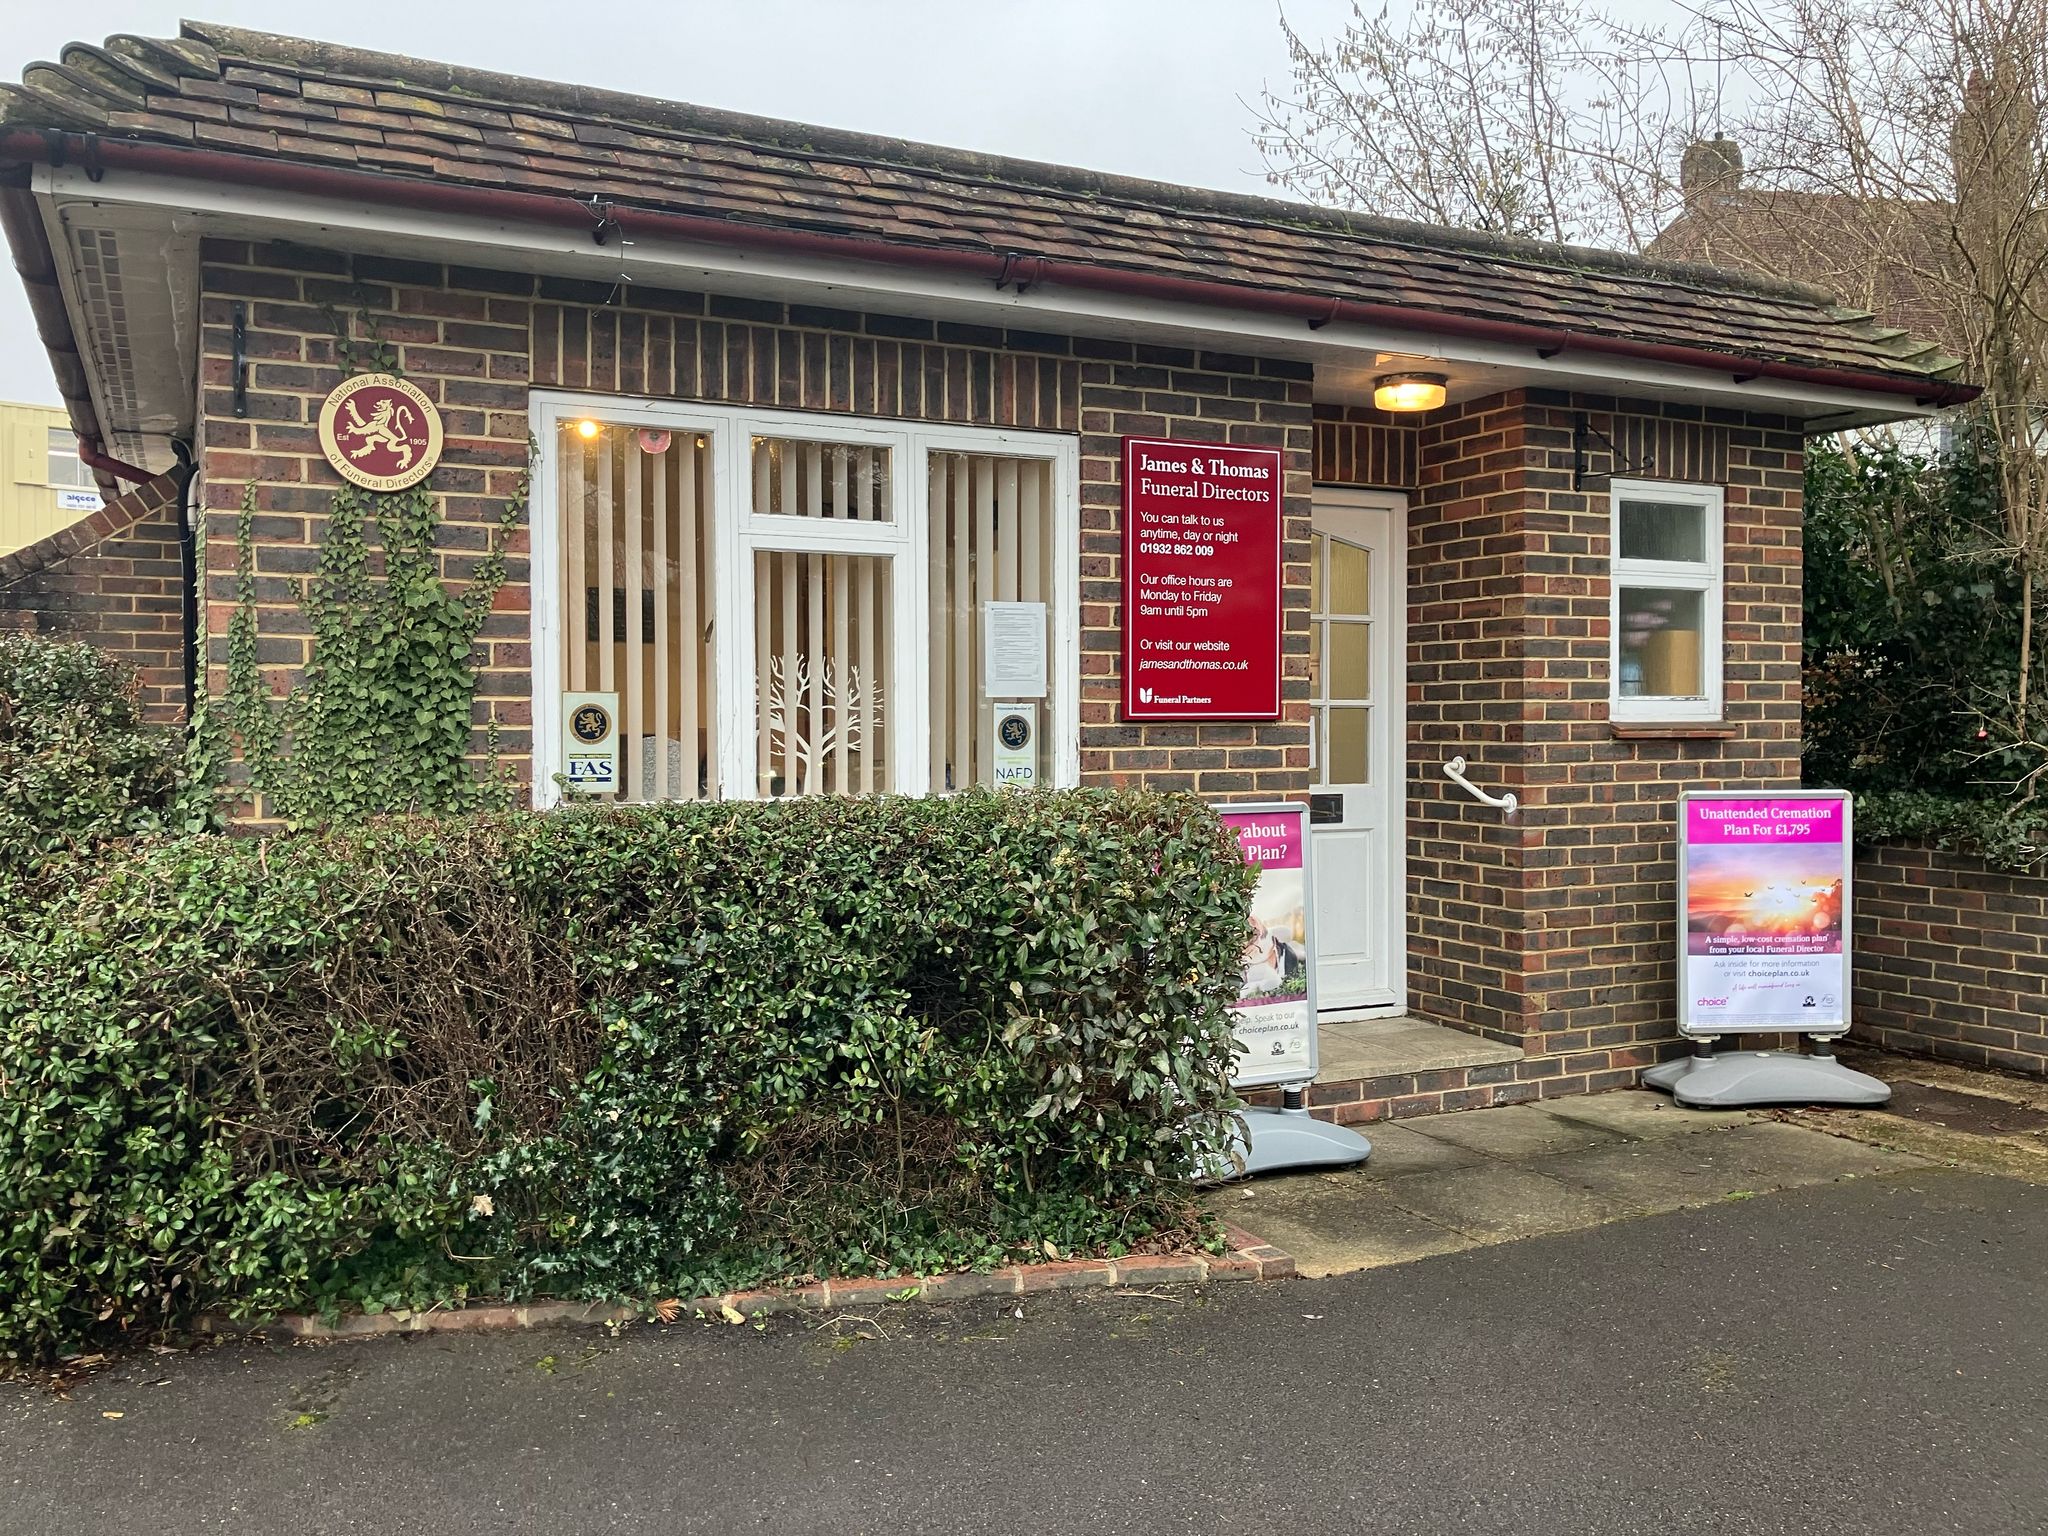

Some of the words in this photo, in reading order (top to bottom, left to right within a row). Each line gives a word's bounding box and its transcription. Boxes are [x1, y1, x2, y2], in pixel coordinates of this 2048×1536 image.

[328, 377, 369, 407] National
[372, 376, 432, 413] Association
[337, 433, 349, 441] Est
[409, 438, 427, 446] 1905
[330, 454, 342, 465] of
[341, 464, 382, 488] Funeral
[1140, 454, 1187, 474] James
[1191, 457, 1205, 475] &
[1208, 458, 1269, 479] Thomas
[1141, 477, 1198, 498] Funeral
[1202, 482, 1270, 502] Directors
[1140, 511, 1158, 523] You
[1161, 514, 1179, 524] can
[1181, 514, 1198, 525] talk
[1201, 515, 1211, 526] to
[1213, 517, 1224, 527] us
[1140, 528, 1180, 541] anytime,
[1183, 529, 1200, 543] day
[1203, 532, 1213, 541] or
[1215, 531, 1239, 544] night
[1140, 542, 1171, 554] 01932
[1174, 544, 1193, 555] 862
[1195, 545, 1214, 556] 009
[1140, 573, 1158, 585] Our
[1161, 574, 1186, 586] office
[1188, 575, 1215, 587] hours
[1217, 578, 1232, 587] are
[1140, 589, 1179, 603] Monday
[1181, 591, 1191, 601] to
[1193, 590, 1222, 604] Friday
[1140, 604, 1161, 615] 9am
[1164, 605, 1184, 616] until
[1186, 606, 1208, 618] 5pm
[1140, 639, 1152, 650] Or
[1155, 640, 1173, 650] visit
[1175, 641, 1191, 650] our
[1193, 640, 1229, 651] website
[1138, 659, 1249, 671] jamesandthomas.co.uk
[1154, 695, 1180, 704] Funeral
[1182, 695, 1212, 704] Partners
[569, 761, 612, 775] FAS
[996, 767, 1033, 779] NAFD
[1700, 807, 1768, 819] Unattended
[1770, 807, 1831, 819] Cremation
[1243, 822, 1287, 838] about
[1724, 823, 1750, 835] Plan
[1753, 824, 1772, 835] For
[1775, 823, 1810, 836] £1,795
[1247, 844, 1287, 861] Plan?
[1705, 936, 1711, 944] A
[1713, 936, 1740, 945] simple,
[1741, 935, 1773, 943] low-cost
[1774, 934, 1810, 943] cremation
[1709, 946, 1727, 954] from
[1728, 946, 1745, 955] your
[1746, 945, 1765, 953] local
[1766, 945, 1795, 953] Funeral
[1796, 945, 1824, 953] Director
[1714, 960, 1726, 968] Ask
[1728, 960, 1747, 968] inside
[1749, 960, 1759, 968] for
[1781, 959, 1819, 968] information
[1748, 969, 1810, 978] choiceplan.co.uk
[1697, 996, 1727, 1007] choice
[1254, 1013, 1274, 1024] Speak
[1238, 1021, 1299, 1035] choiceplan.co.uk
